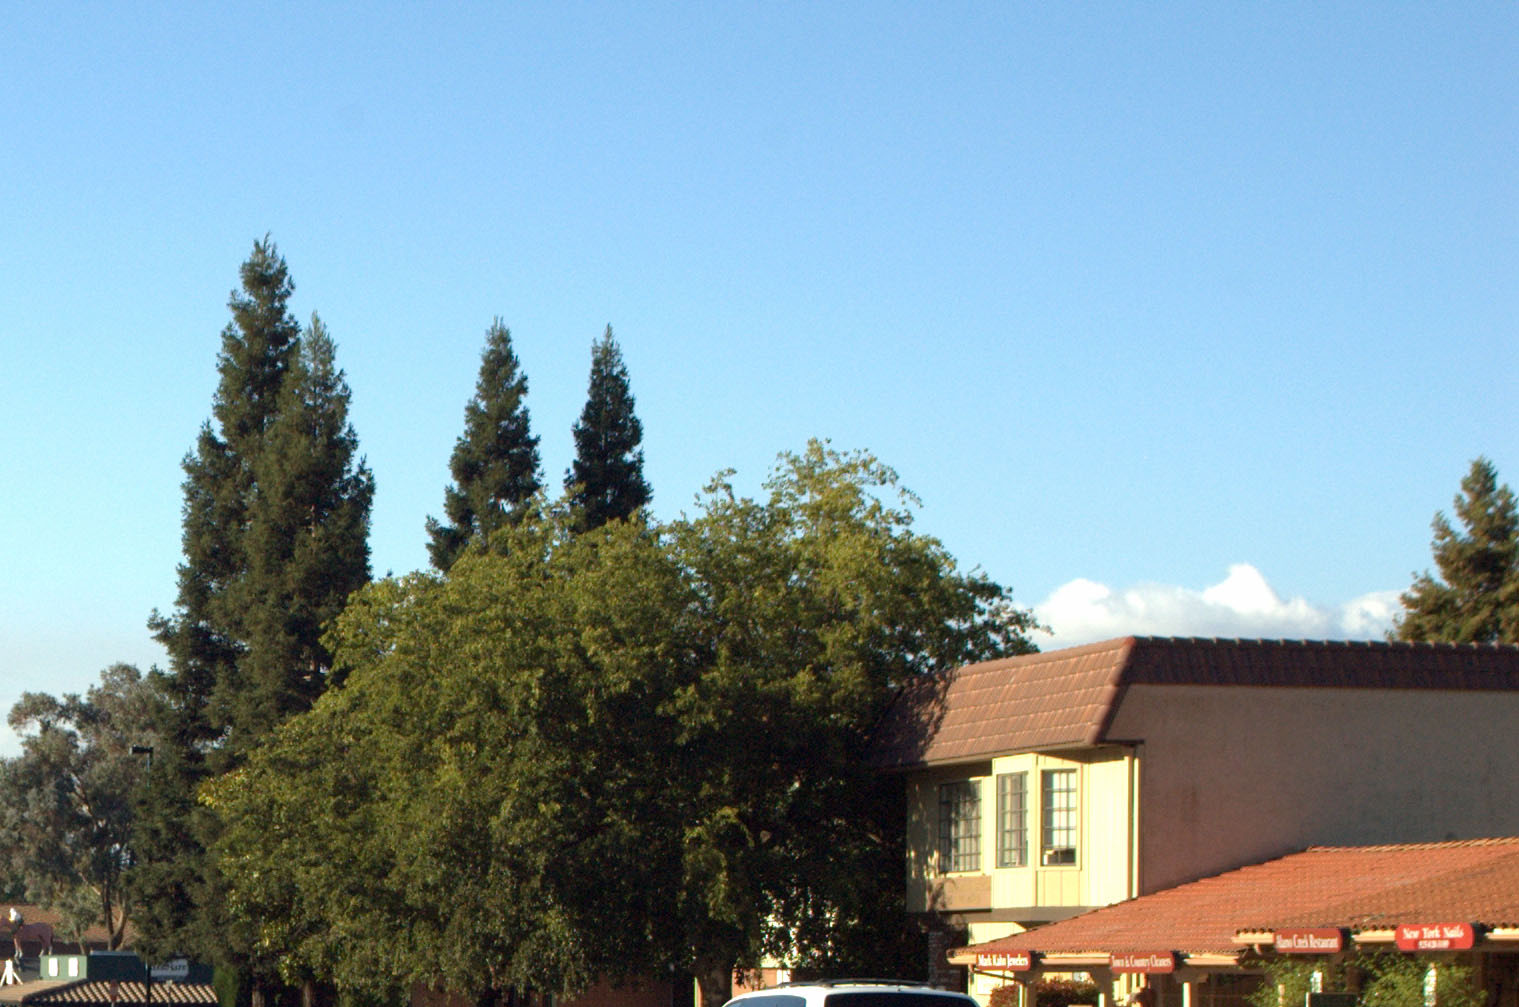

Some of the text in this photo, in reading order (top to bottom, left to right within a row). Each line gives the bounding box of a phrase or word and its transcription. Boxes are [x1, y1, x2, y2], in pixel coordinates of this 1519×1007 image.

[1402, 925, 1465, 939] New York Nails
[1007, 953, 1029, 968] Jewelers
